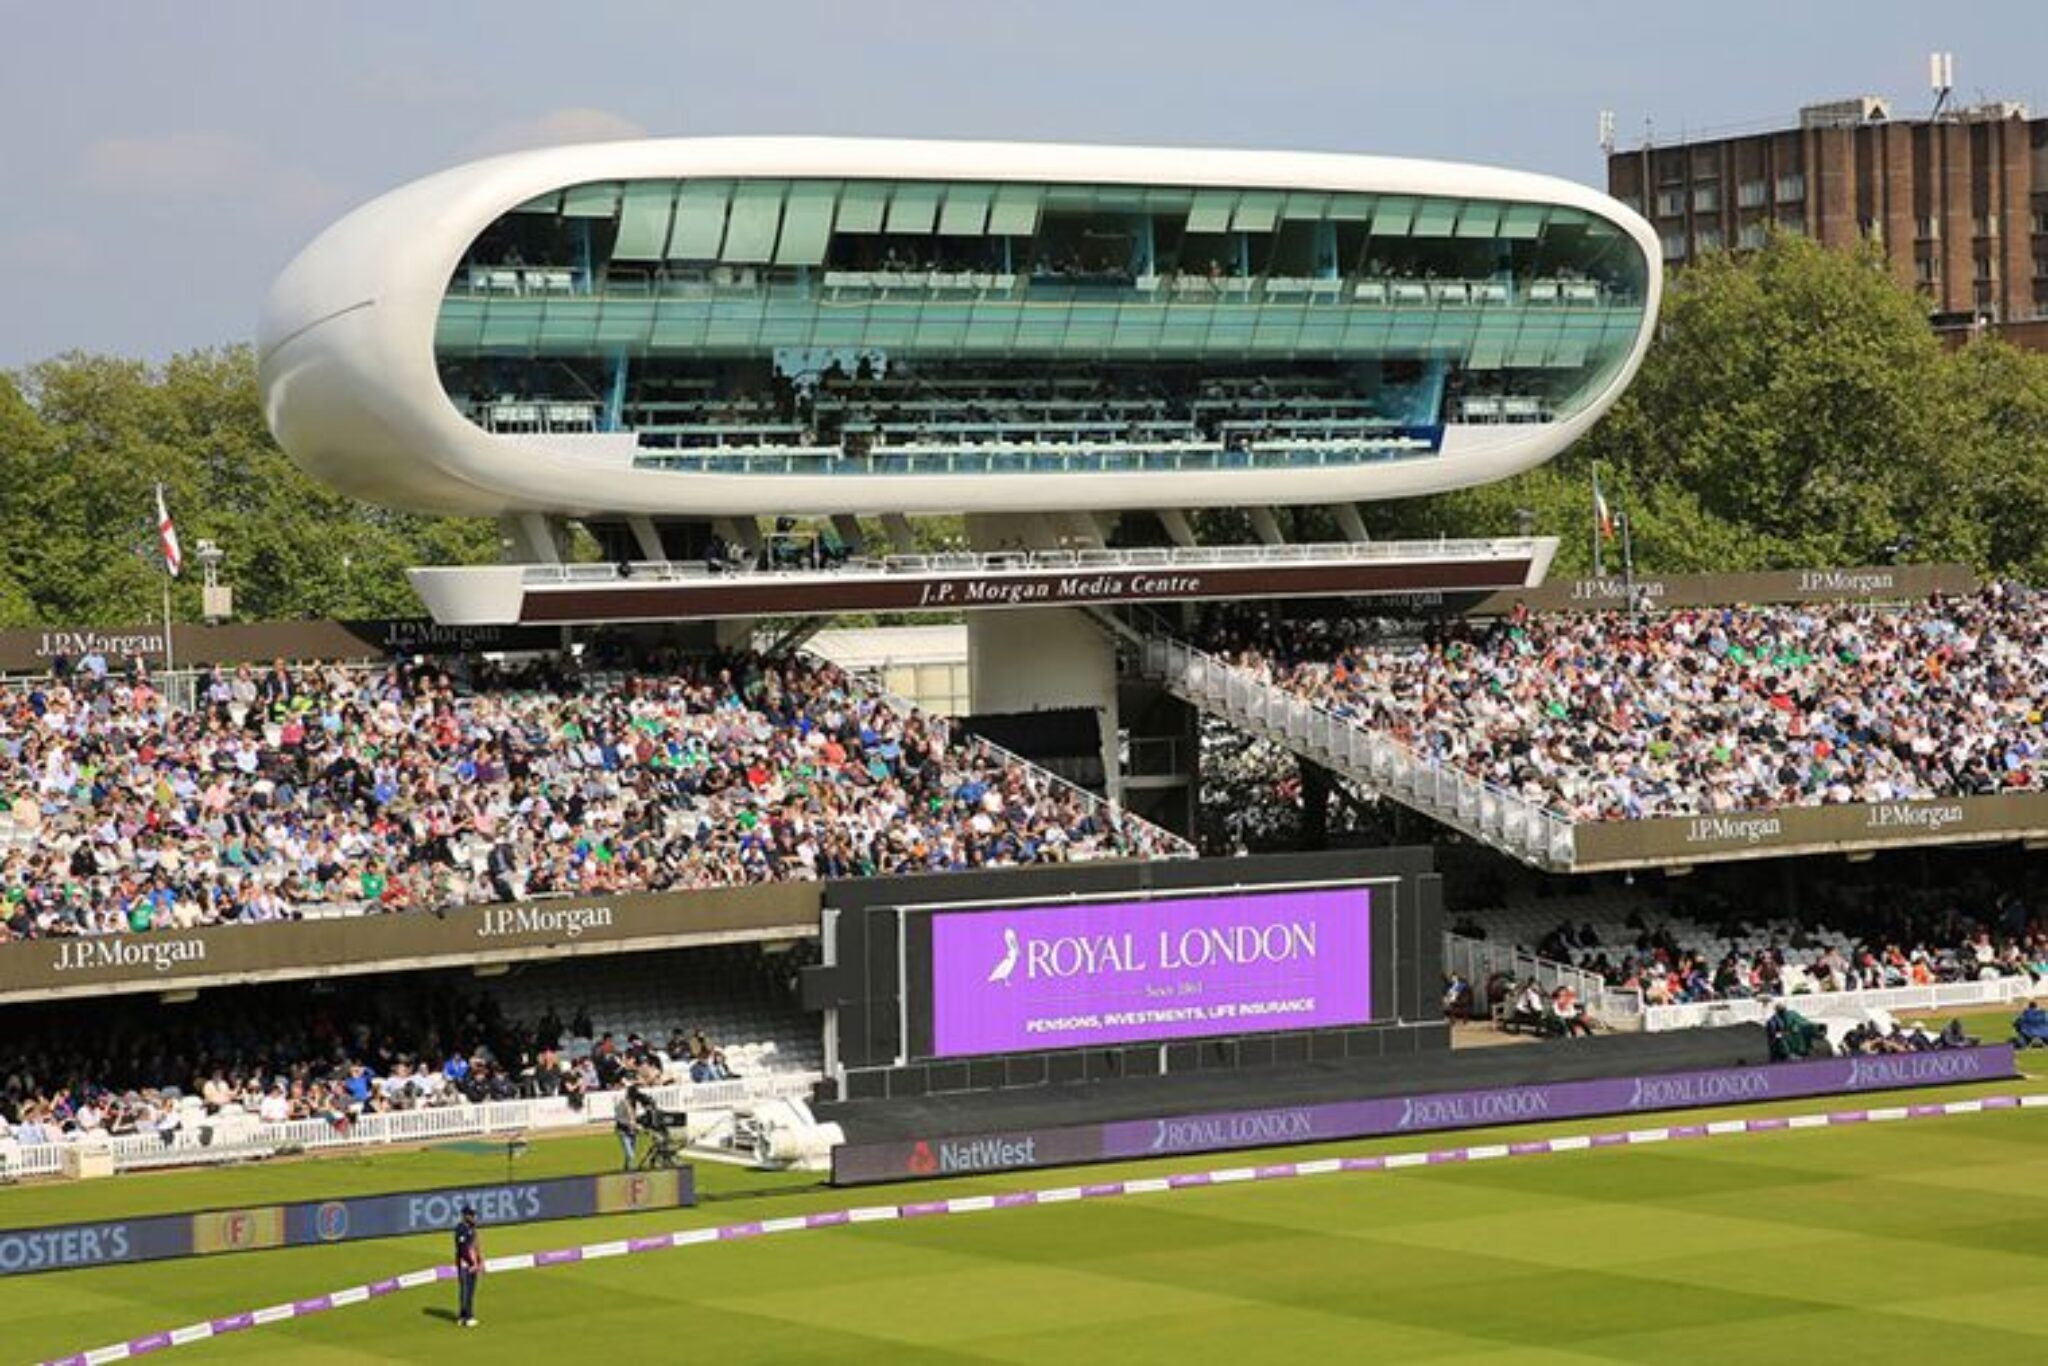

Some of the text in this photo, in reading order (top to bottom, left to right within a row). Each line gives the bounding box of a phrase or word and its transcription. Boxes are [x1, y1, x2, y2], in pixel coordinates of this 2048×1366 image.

[920, 574, 1201, 604] J.P. Morgan Media Centre
[35, 632, 164, 660] J.PMorgan
[476, 906, 613, 938] J.P.Morgan
[52, 938, 206, 971] J.P.Morgan
[1027, 920, 1317, 979] ROYAL LONDON
[1026, 998, 1316, 1033] PENSIONS, INVESTMENTS, LIFE INSURANCE
[1859, 1054, 1979, 1085] ROYAL LONDON
[1643, 1072, 1769, 1105] ROYAL LONDON
[1413, 1090, 1550, 1124] ROYAL LONDON
[1168, 1111, 1311, 1146] ROYAL LONDON
[939, 1136, 1036, 1172] NatWest
